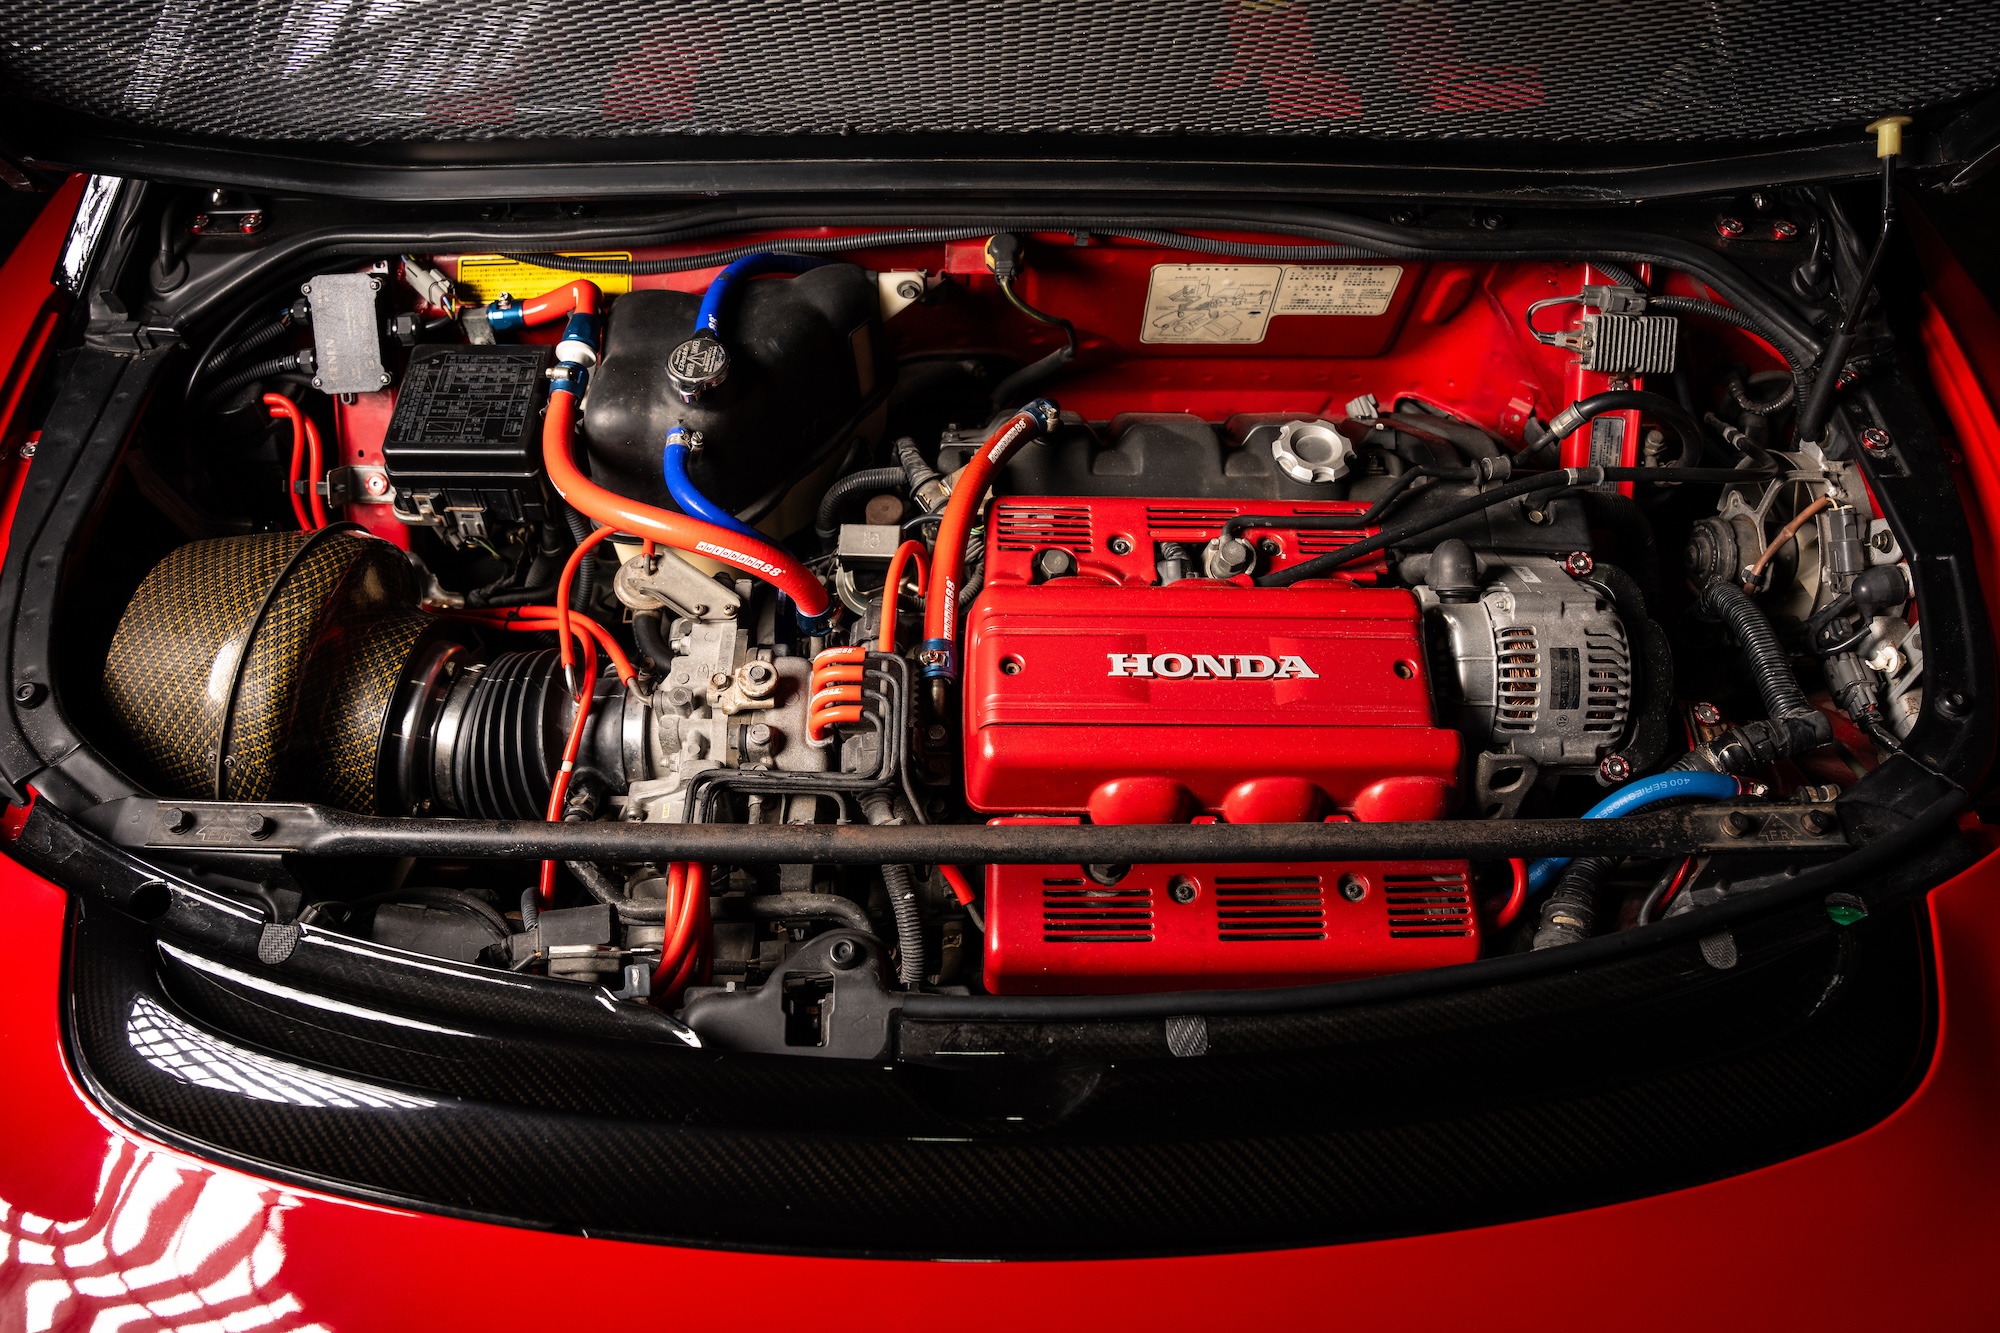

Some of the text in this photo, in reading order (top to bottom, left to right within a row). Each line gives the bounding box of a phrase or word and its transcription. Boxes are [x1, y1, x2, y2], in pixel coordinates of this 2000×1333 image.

[695, 541, 783, 577] autobahn88
[1107, 653, 1320, 680] HONDA
[1669, 778, 1691, 787] 400
[1628, 781, 1668, 801] SERIES
[207, 829, 228, 841] FR
[1769, 829, 1790, 841] FR
